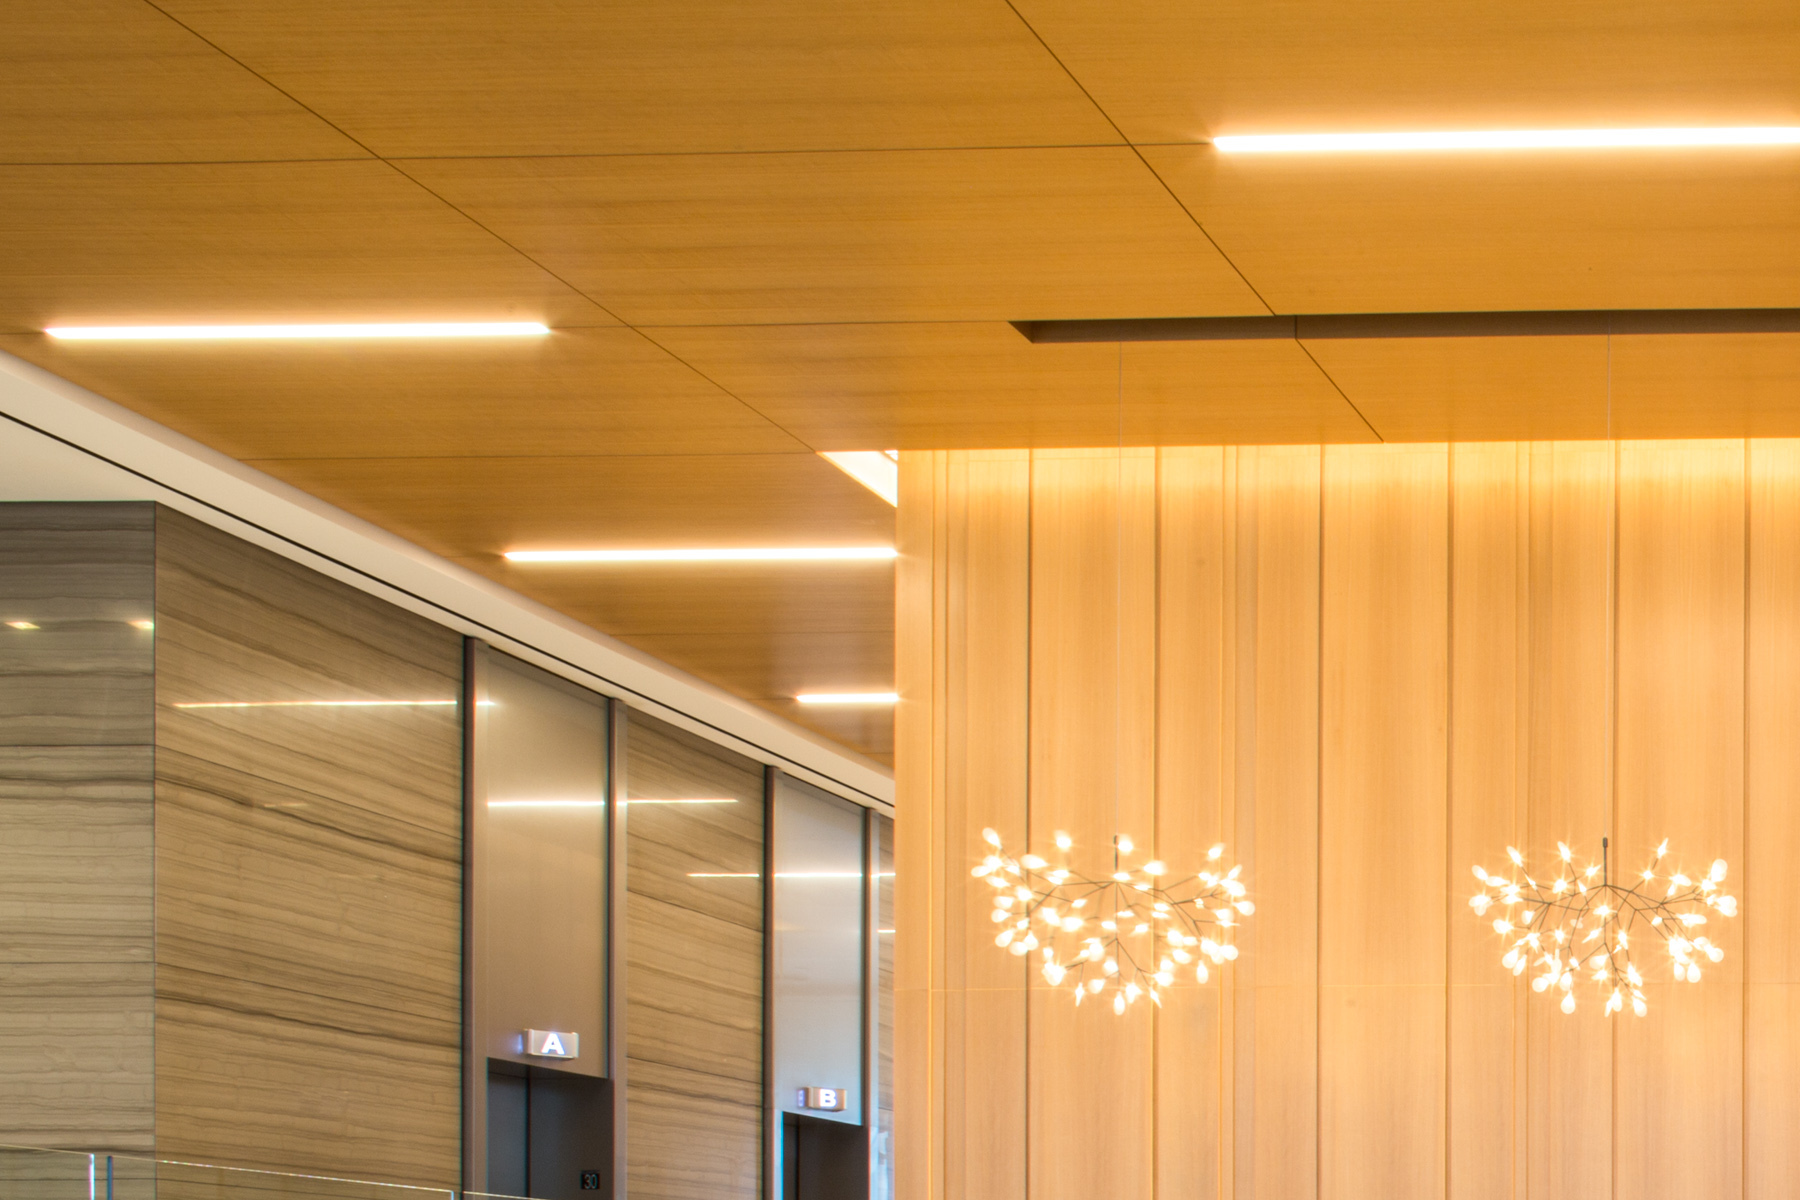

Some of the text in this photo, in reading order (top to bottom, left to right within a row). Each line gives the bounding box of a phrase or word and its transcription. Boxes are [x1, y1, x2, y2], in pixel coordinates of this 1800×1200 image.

[540, 1032, 566, 1056] A
[818, 1088, 838, 1109] B
[583, 1173, 599, 1190] 30
